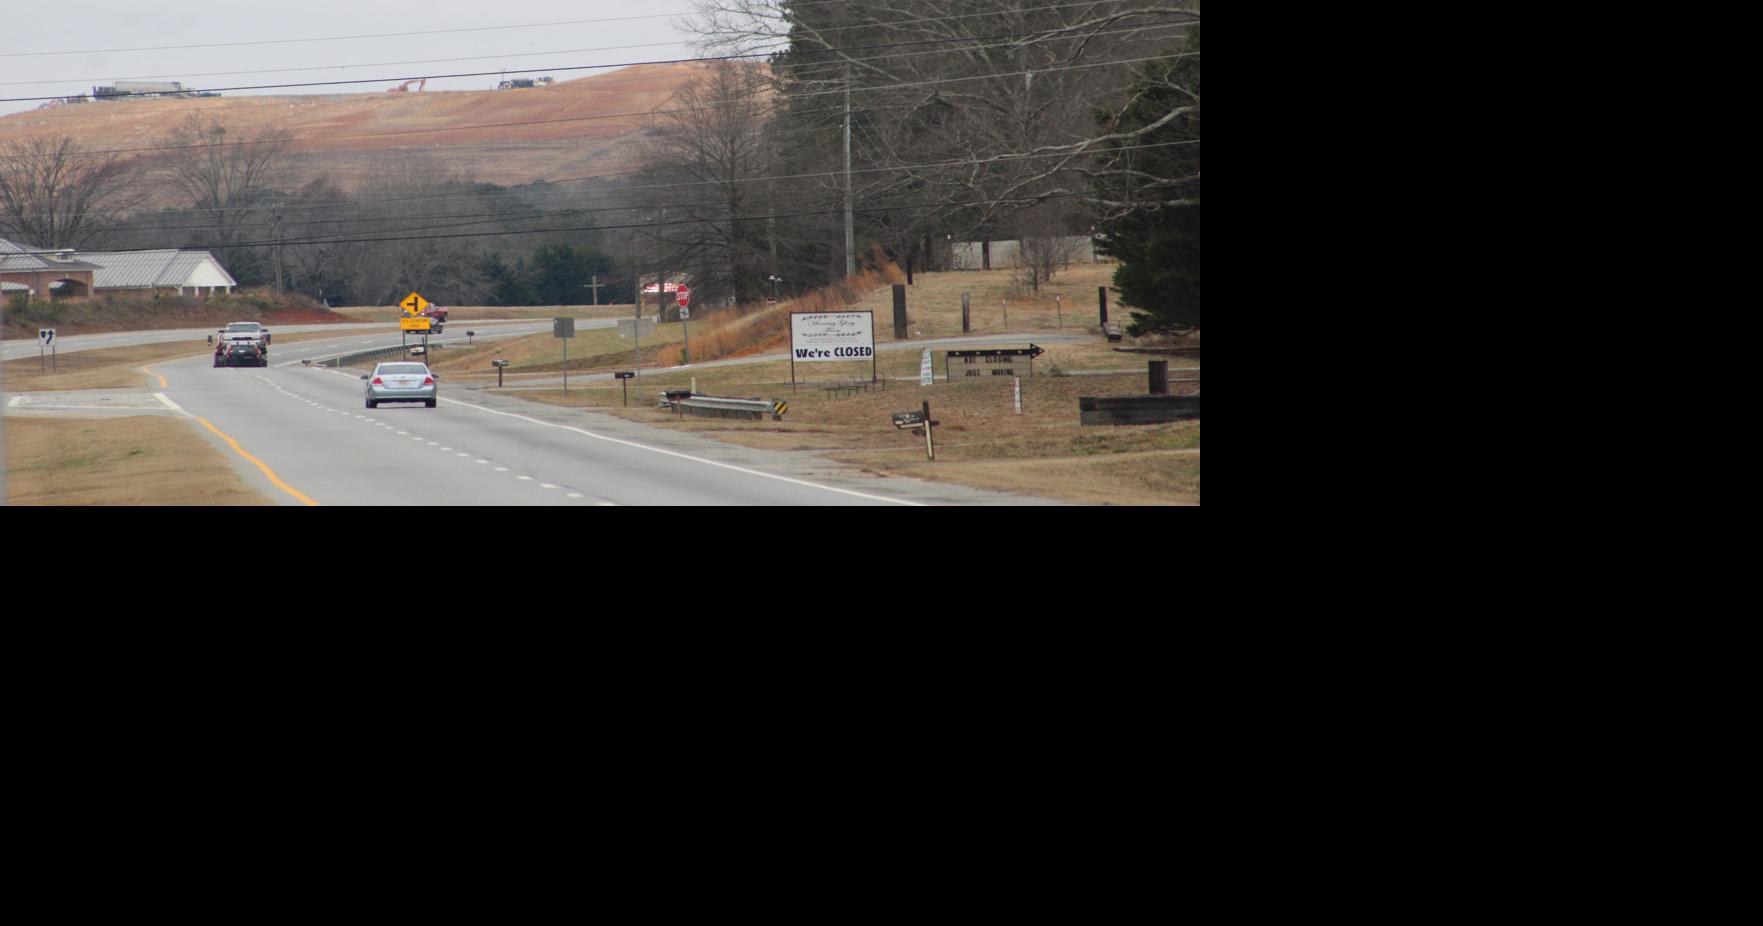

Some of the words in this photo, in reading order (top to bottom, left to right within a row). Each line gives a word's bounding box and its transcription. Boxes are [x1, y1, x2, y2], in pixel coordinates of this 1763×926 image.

[676, 292, 688, 300] STOP
[795, 348, 831, 358] We're
[834, 346, 872, 357] CLOSED
